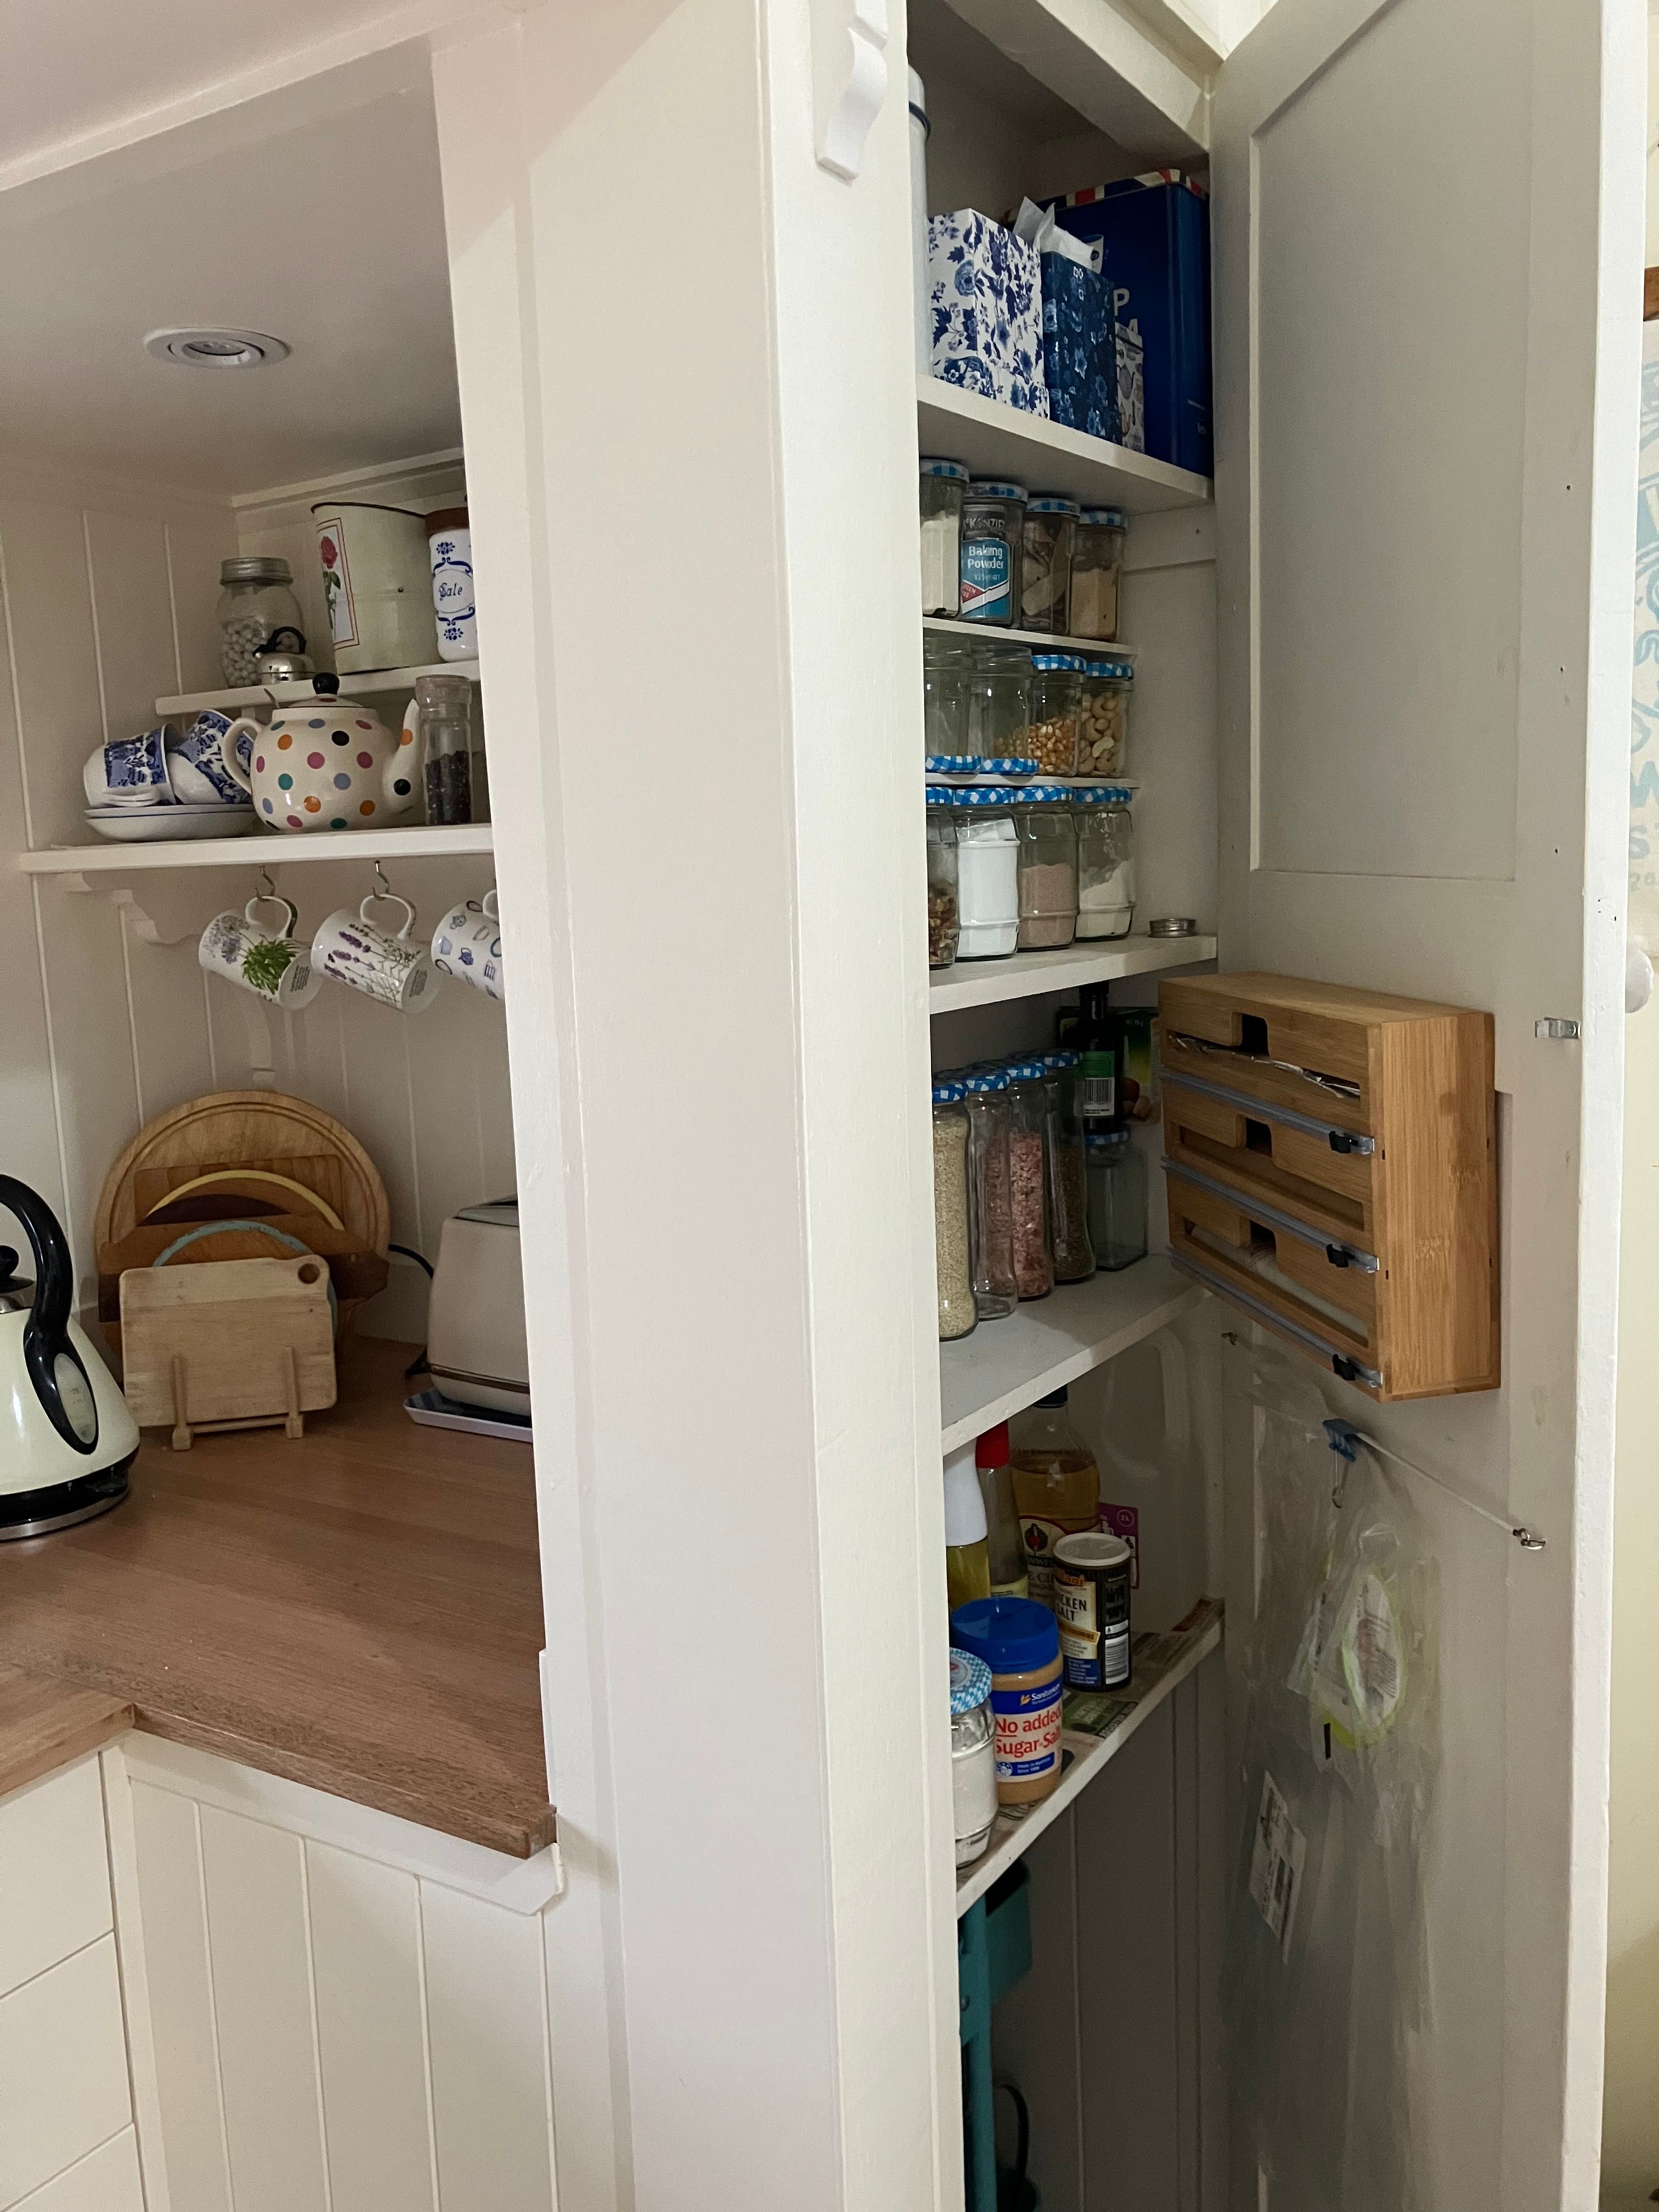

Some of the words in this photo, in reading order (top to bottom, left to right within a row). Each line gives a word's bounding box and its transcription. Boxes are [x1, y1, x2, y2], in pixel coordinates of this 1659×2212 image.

[969, 545, 1003, 559] Baking
[968, 558, 1003, 569] Powder
[995, 1718, 1018, 1733] No
[1023, 1702, 1061, 1732] added
[996, 1739, 1040, 1758] Sugar
